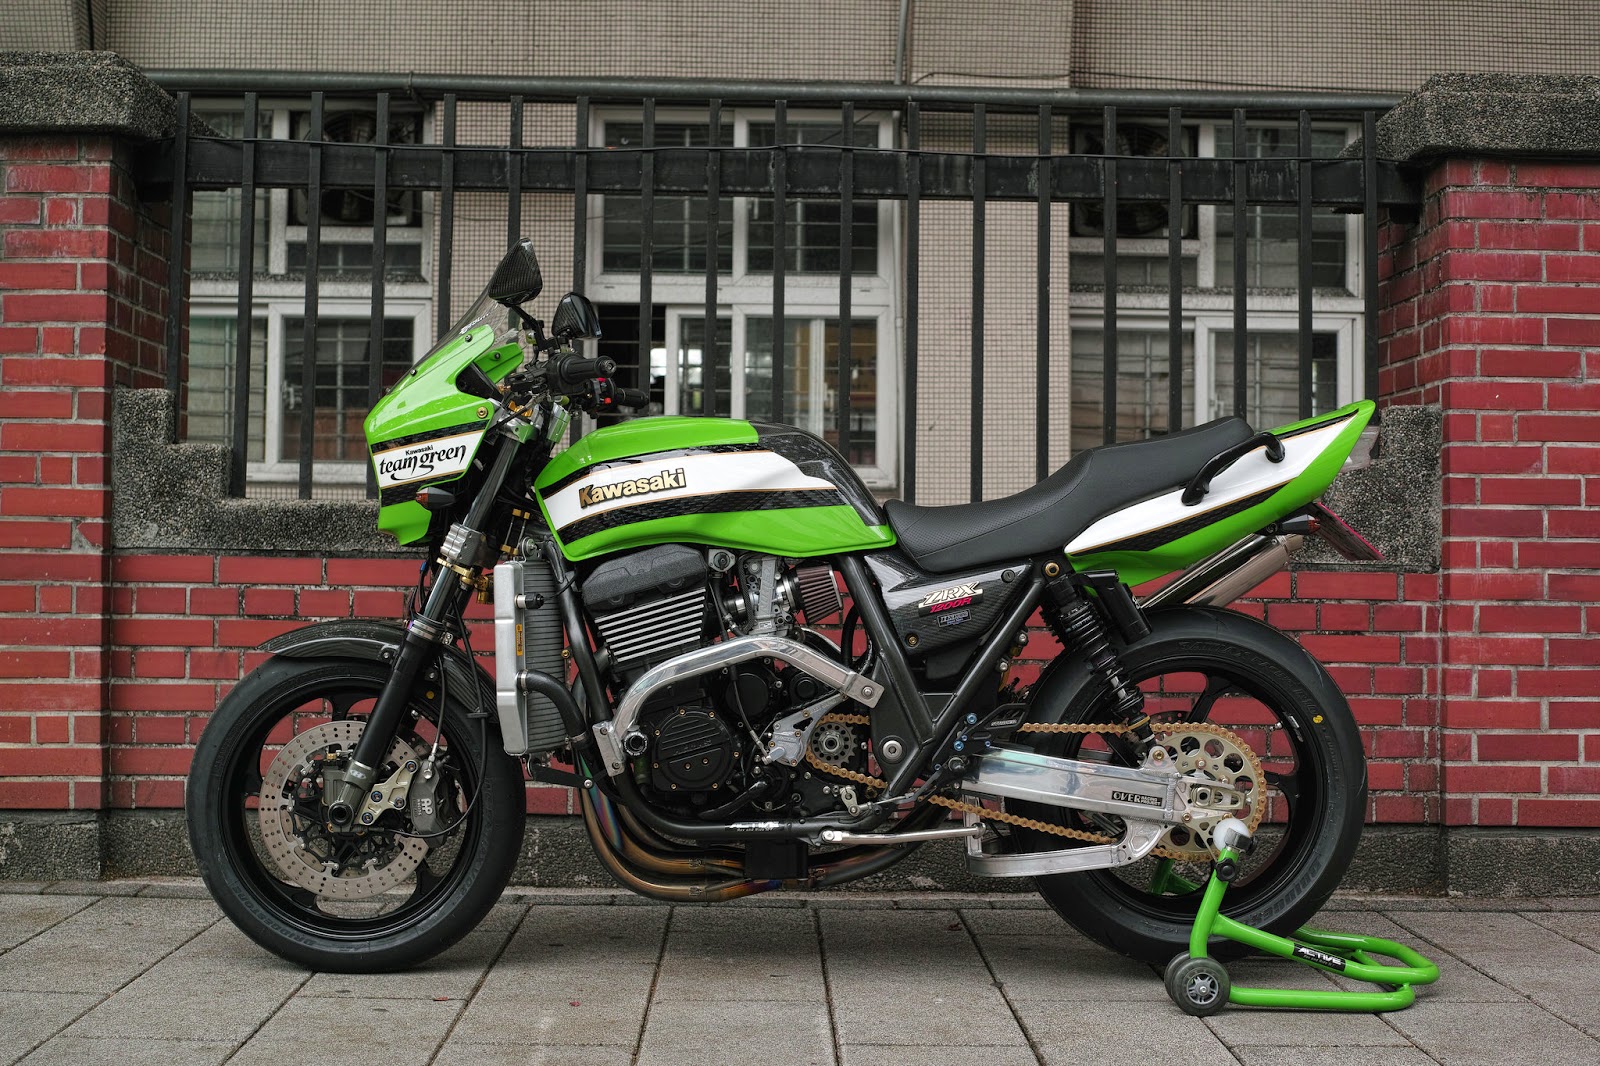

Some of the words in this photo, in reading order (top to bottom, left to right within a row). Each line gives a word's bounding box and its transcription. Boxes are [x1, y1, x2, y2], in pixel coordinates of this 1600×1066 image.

[405, 444, 434, 456] Kawasaki
[579, 468, 687, 509] Kawasaki
[923, 581, 980, 606] ZRX
[930, 596, 973, 613] 1200R
[1113, 791, 1141, 803] OVER
[1297, 947, 1342, 965] ACTIVE
